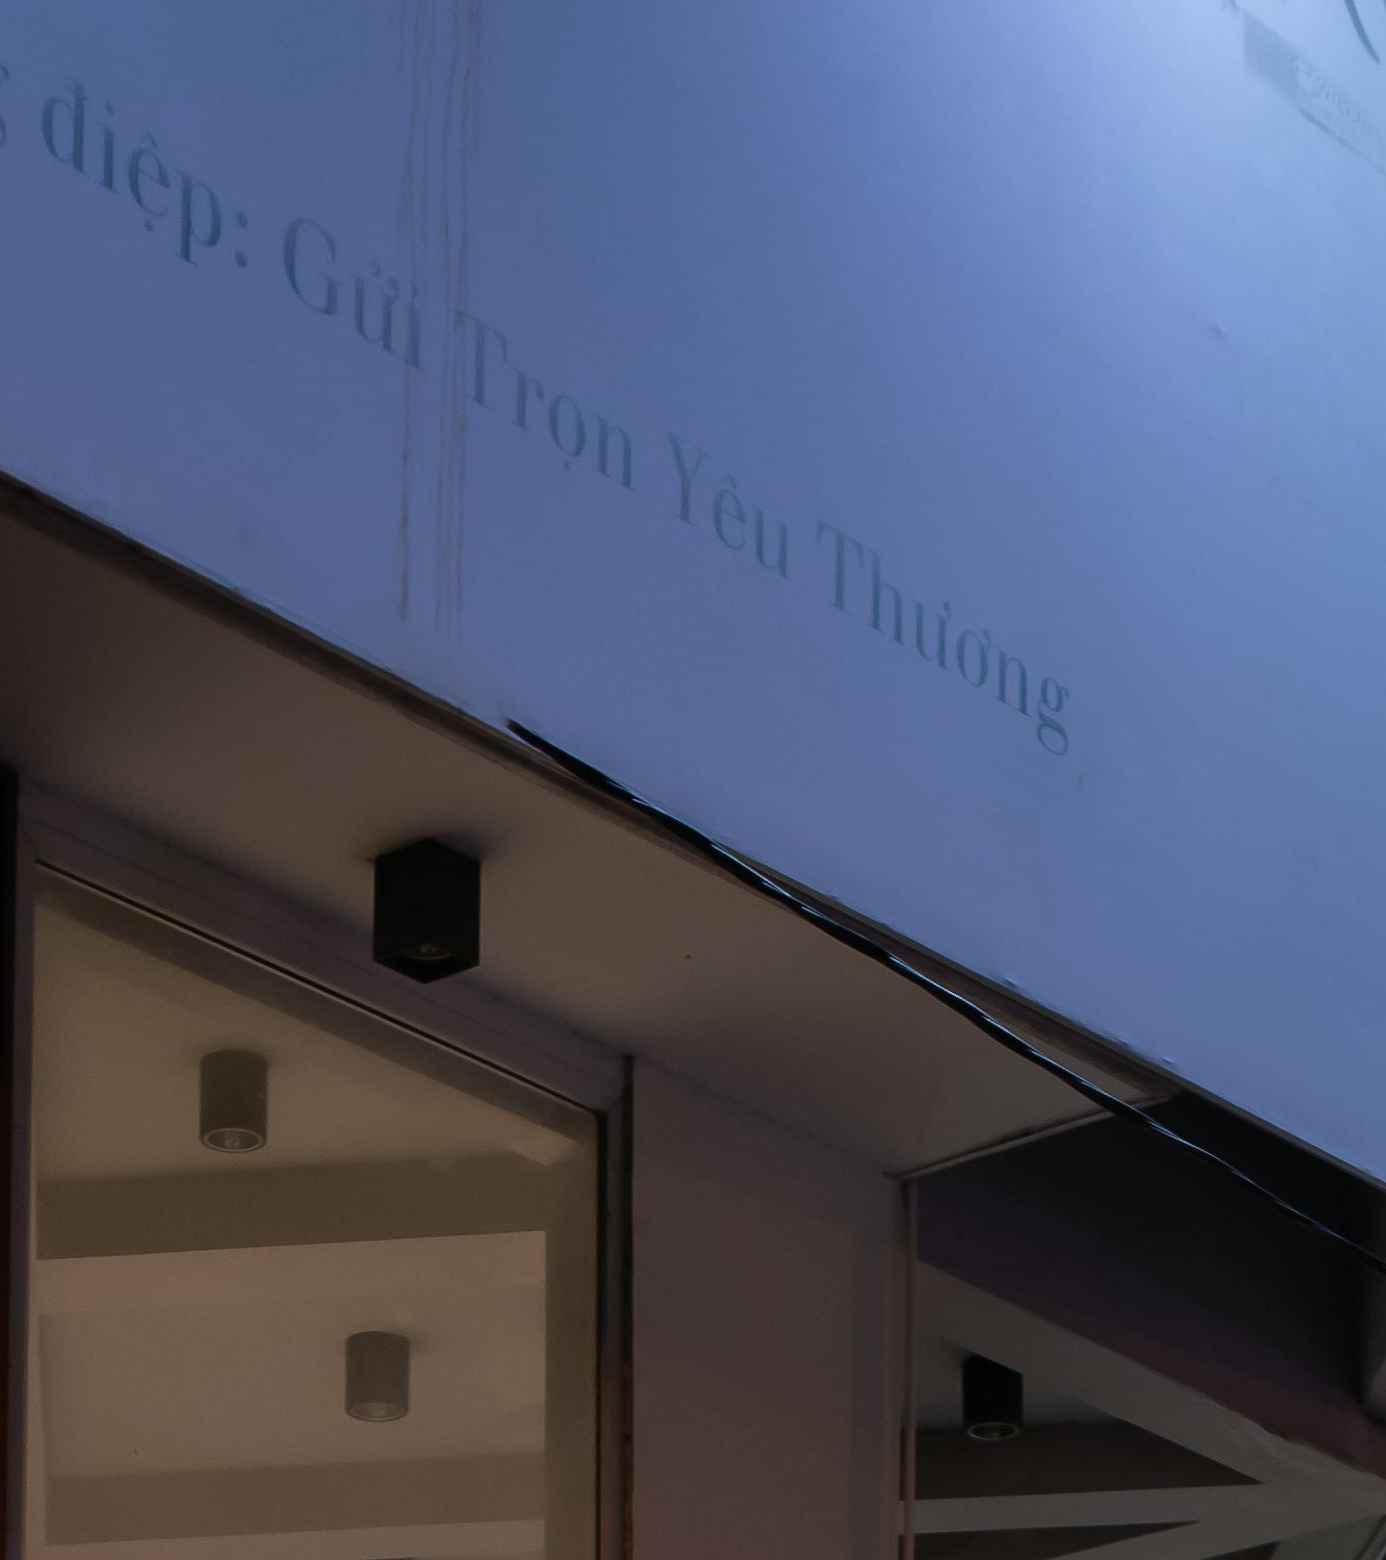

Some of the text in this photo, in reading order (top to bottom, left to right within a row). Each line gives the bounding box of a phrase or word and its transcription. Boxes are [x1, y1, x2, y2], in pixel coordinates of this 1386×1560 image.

[40, 74, 249, 268] điệp:
[283, 216, 426, 373] Gửi
[453, 307, 637, 493] Trọn
[662, 427, 791, 583] Yêu
[816, 518, 1070, 757] Thương
